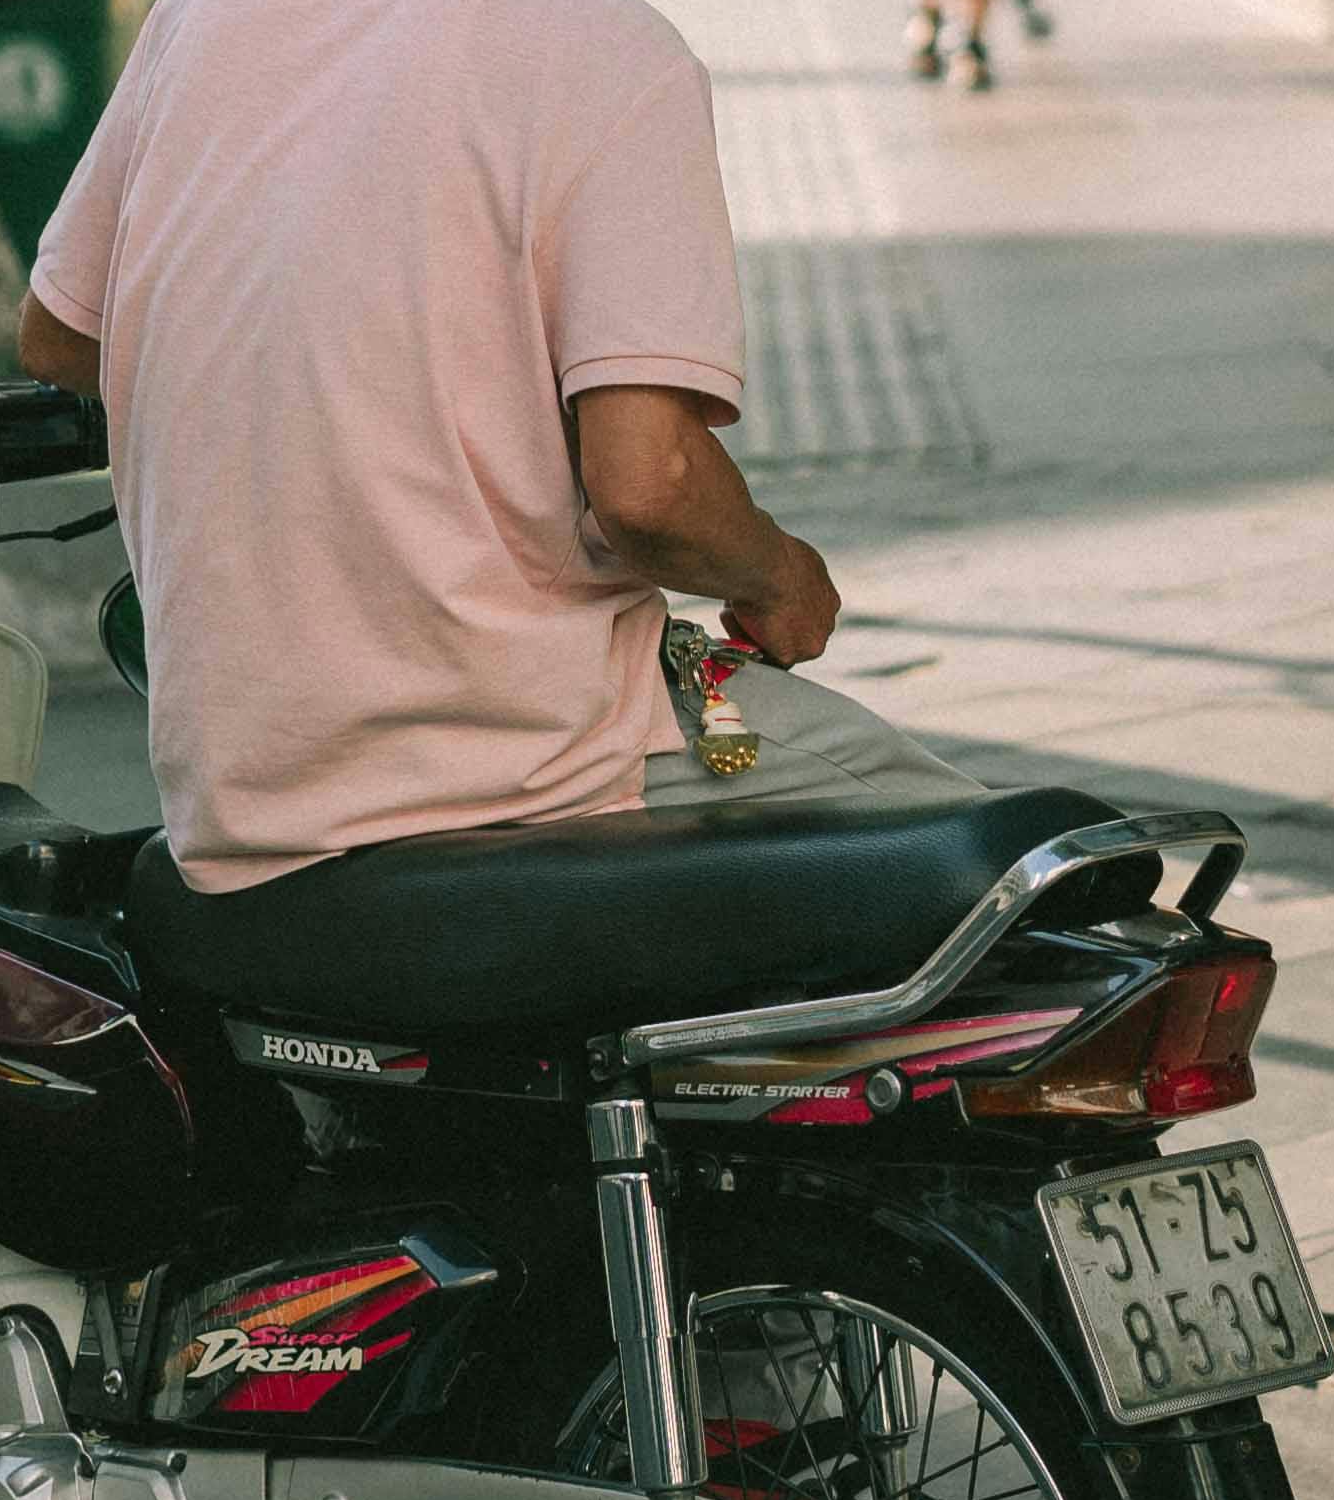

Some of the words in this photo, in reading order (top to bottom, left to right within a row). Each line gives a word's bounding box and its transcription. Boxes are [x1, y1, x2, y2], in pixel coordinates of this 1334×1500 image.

[262, 1034, 381, 1073] HONDA
[674, 1083, 761, 1097] ELECTRIC
[764, 1085, 850, 1099] STARTER
[249, 1325, 359, 1347] Super
[1123, 1273, 1295, 1389] 8539
[186, 1328, 363, 1378] DREAM
